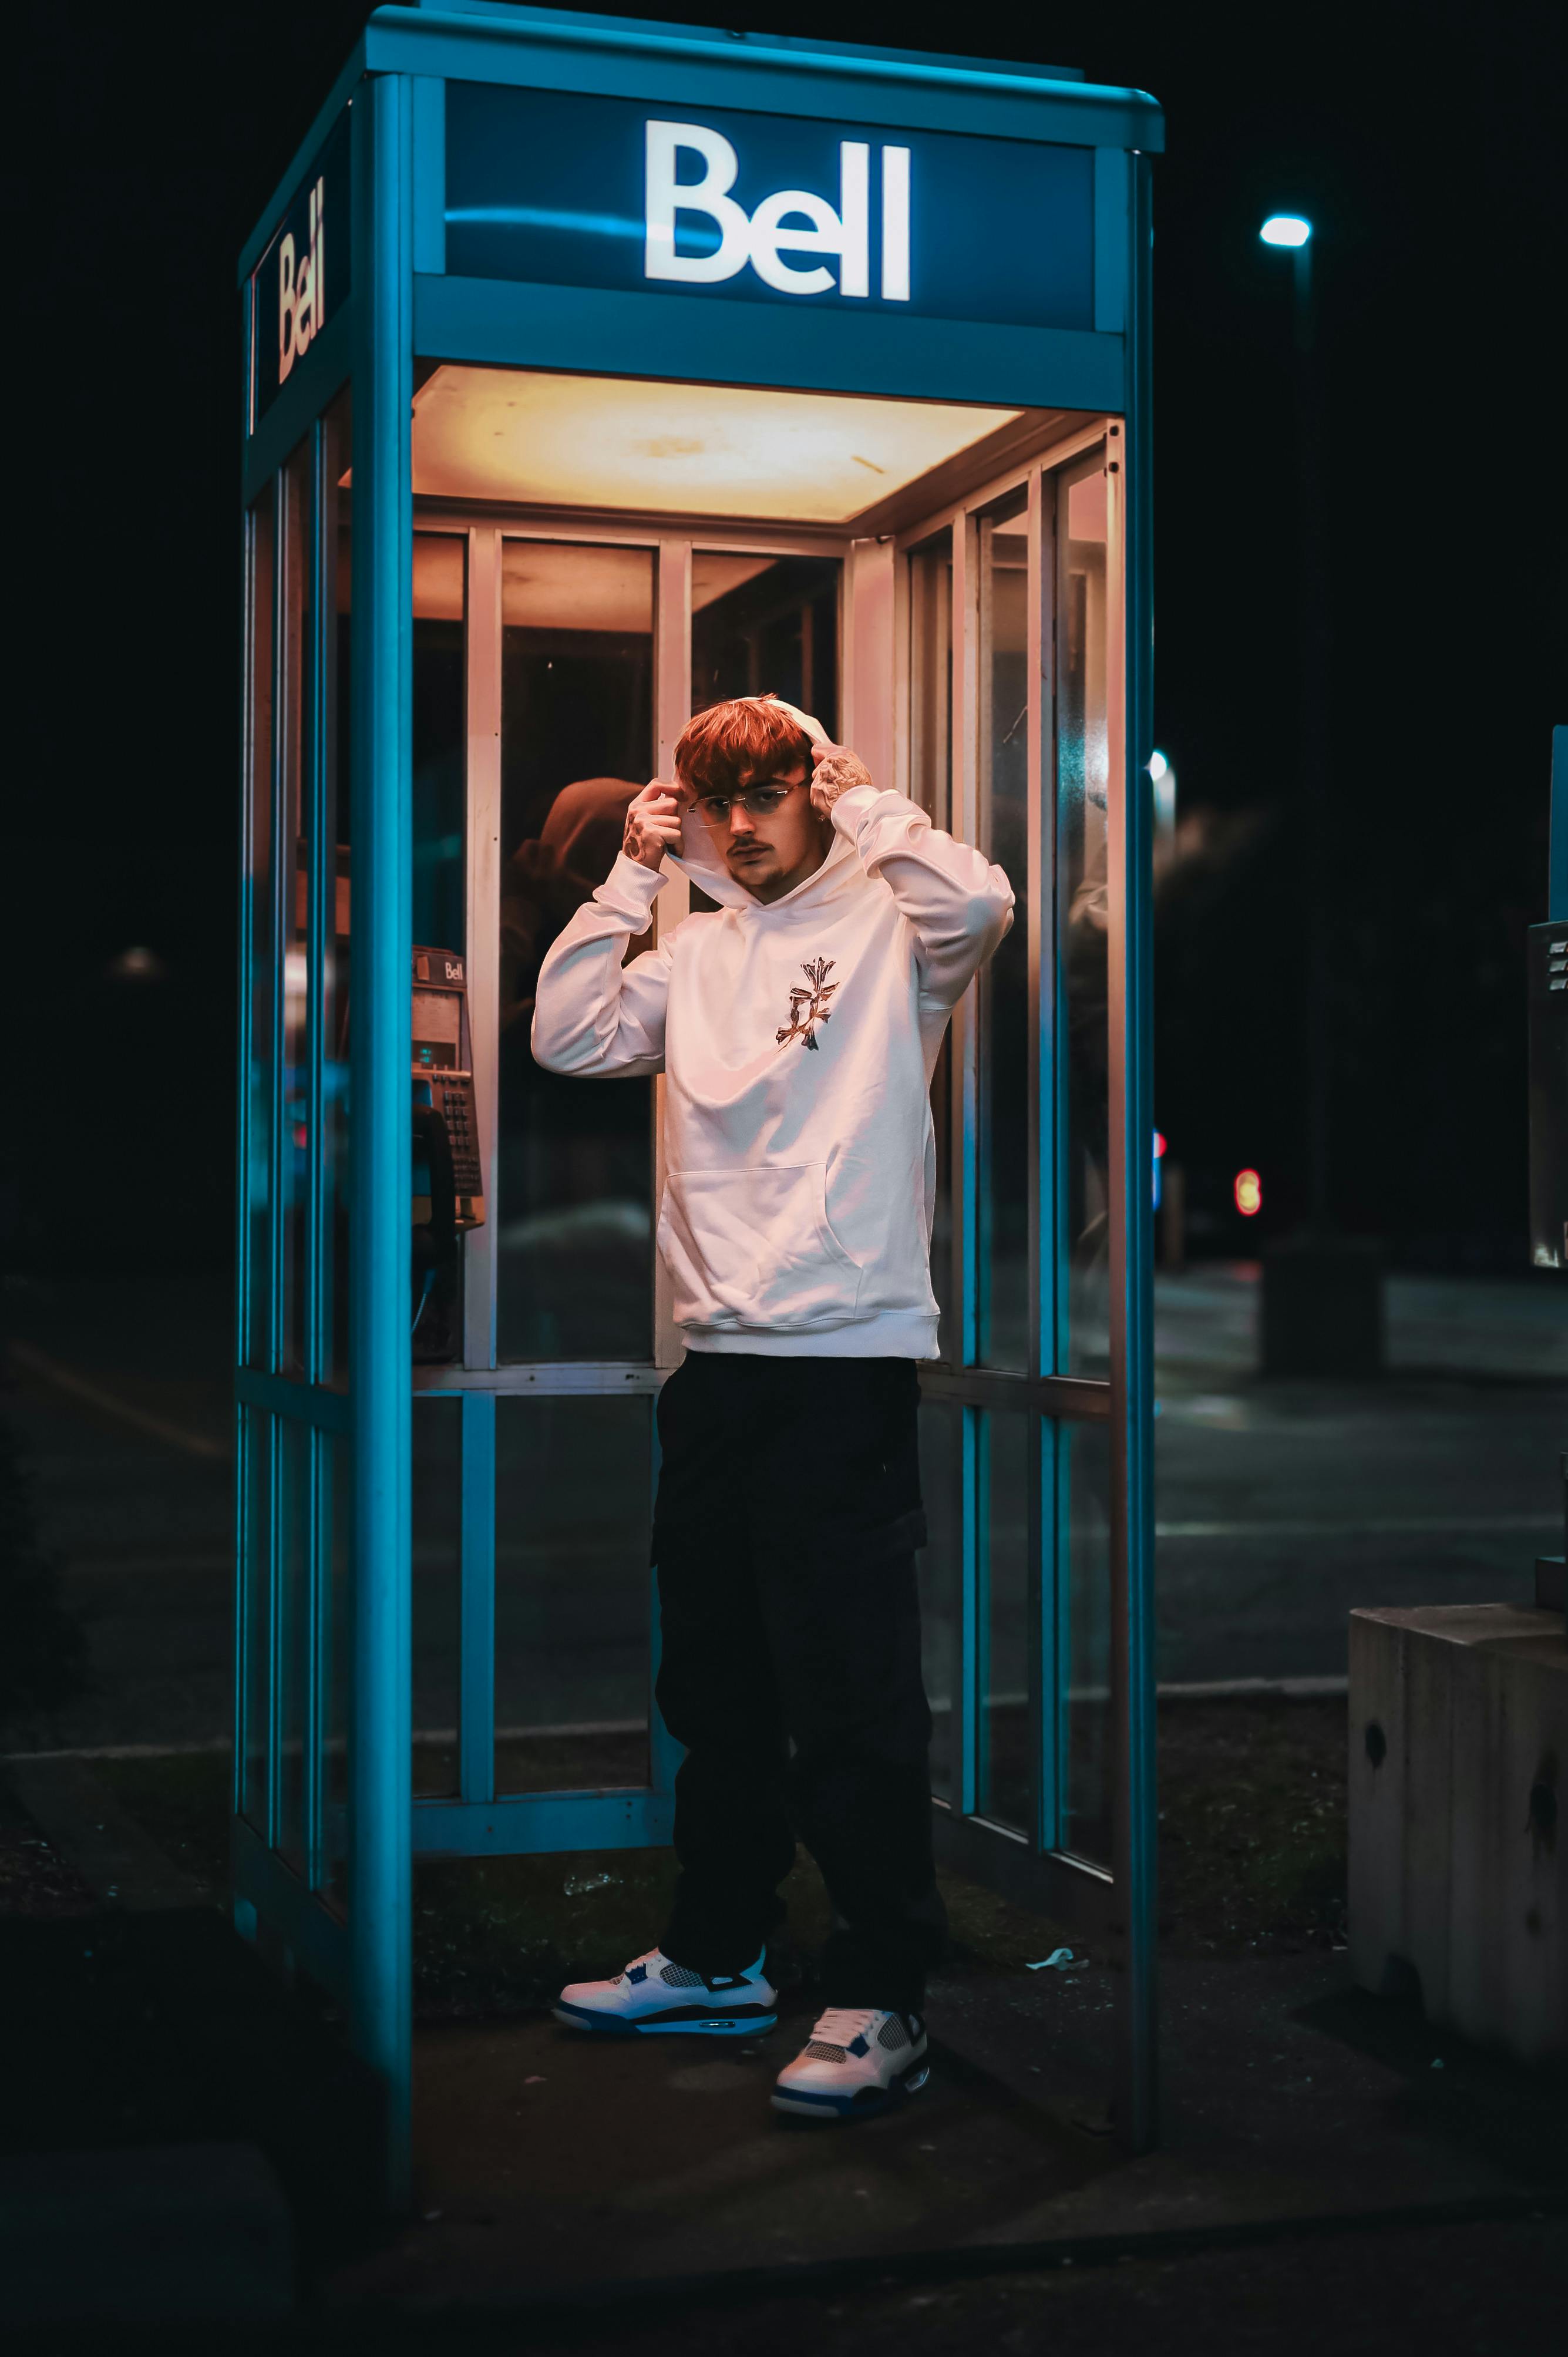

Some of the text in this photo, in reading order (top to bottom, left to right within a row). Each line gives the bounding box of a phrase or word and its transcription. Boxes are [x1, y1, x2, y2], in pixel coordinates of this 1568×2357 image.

[280, 176, 324, 385] Bell
[645, 120, 910, 301] Bell
[445, 961, 463, 980] Bell
